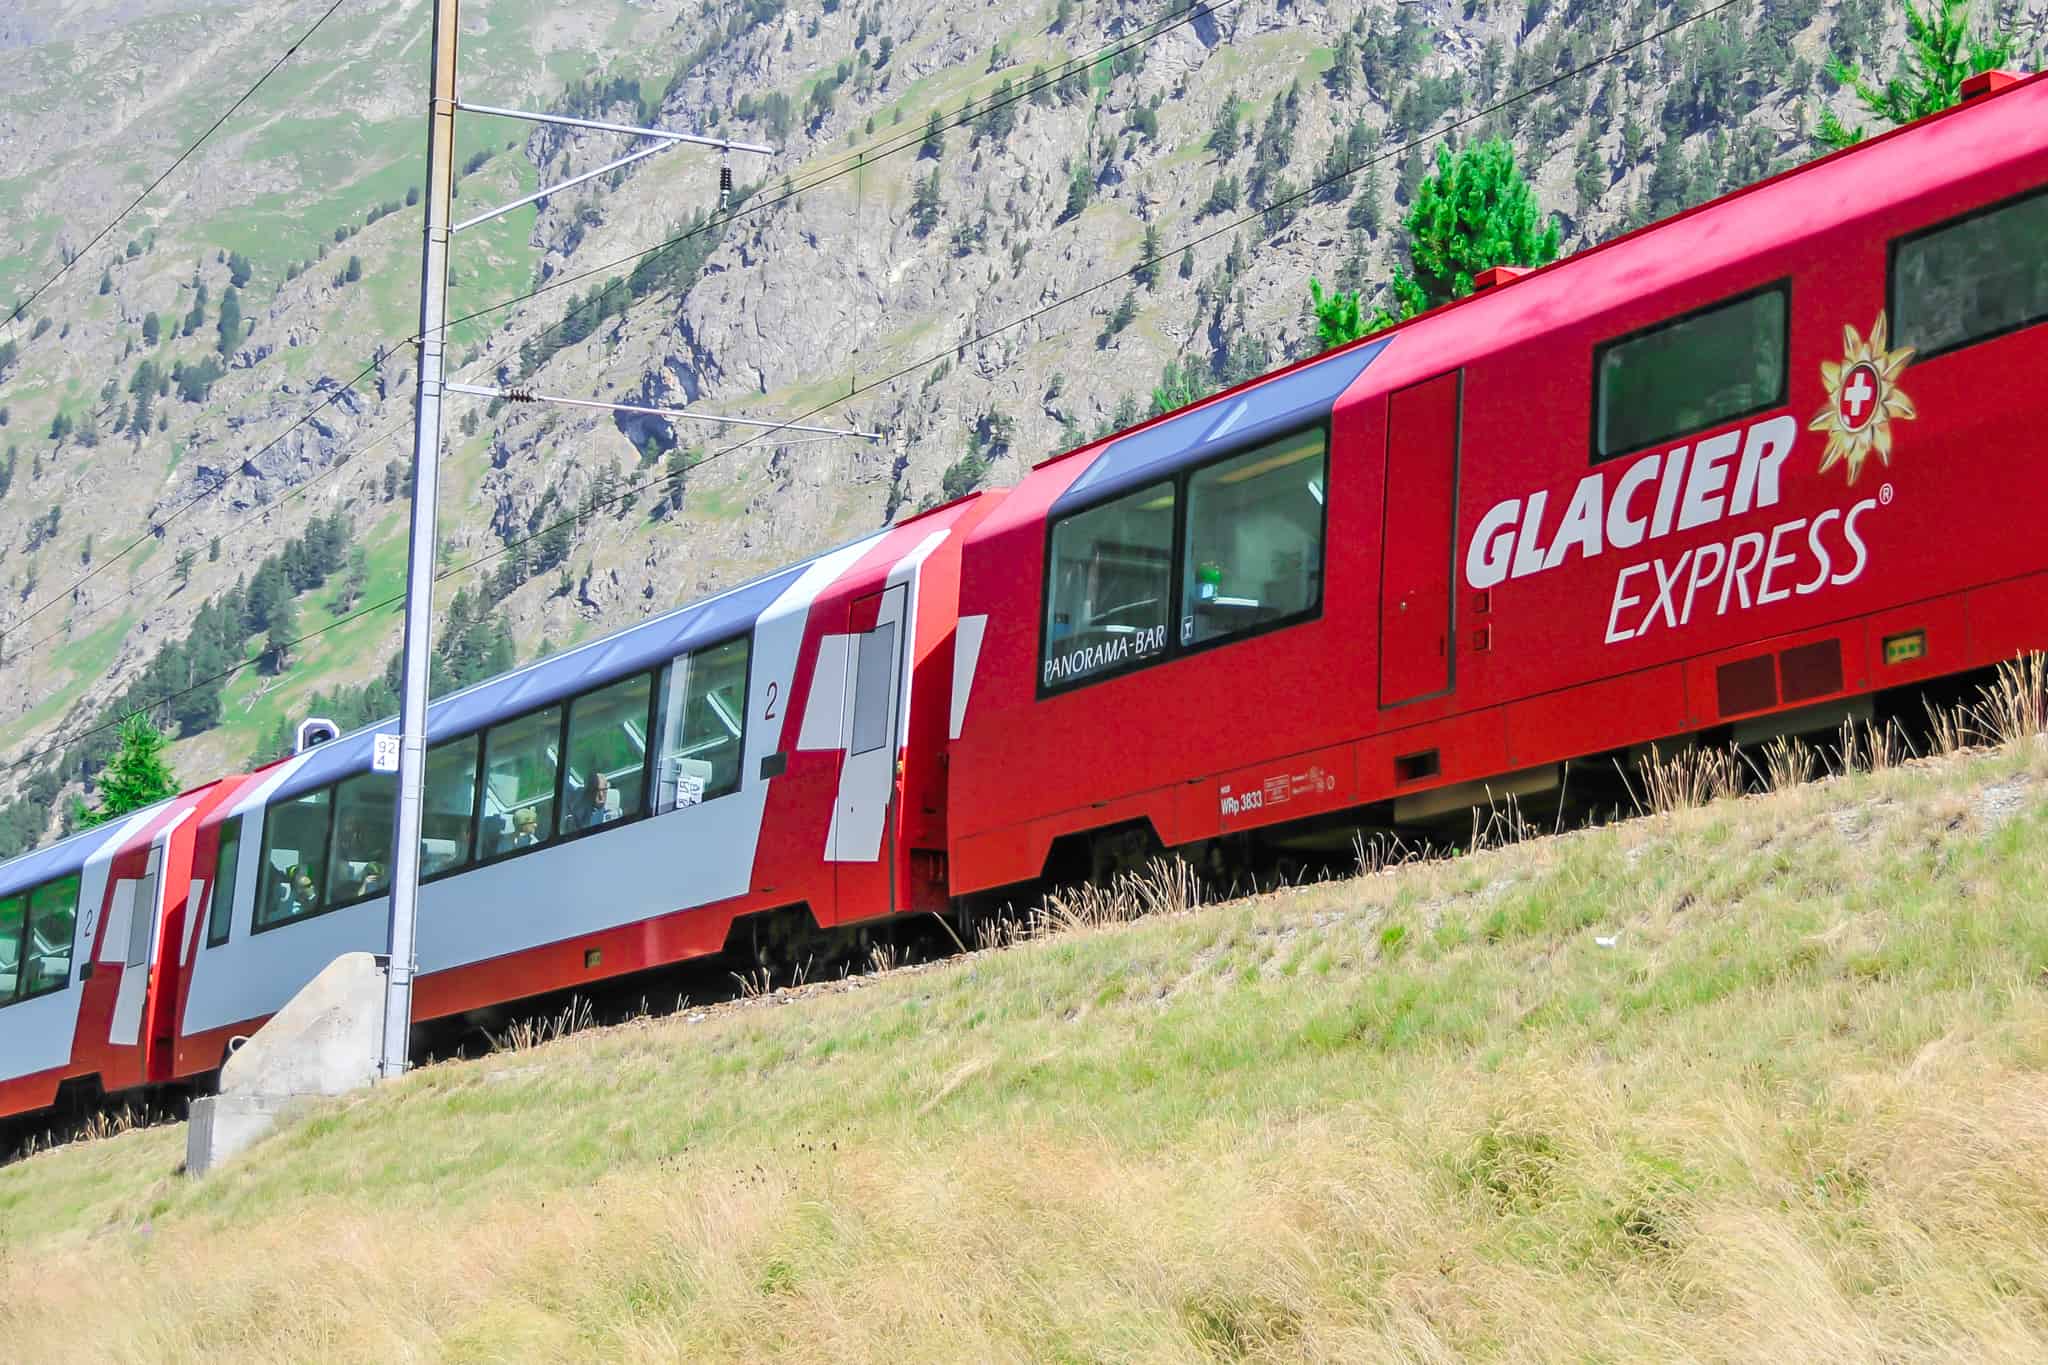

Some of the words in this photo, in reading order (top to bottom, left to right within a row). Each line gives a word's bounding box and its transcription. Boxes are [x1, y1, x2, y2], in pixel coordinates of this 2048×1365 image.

[1466, 415, 1796, 588] GLACIER
[1604, 498, 1876, 644] EXPRESS
[1043, 625, 1165, 682] PANORAMA-BAR
[765, 681, 778, 720] 2
[1221, 797, 1240, 816] WRp
[1240, 790, 1263, 811] 3833
[85, 909, 93, 937] 2
